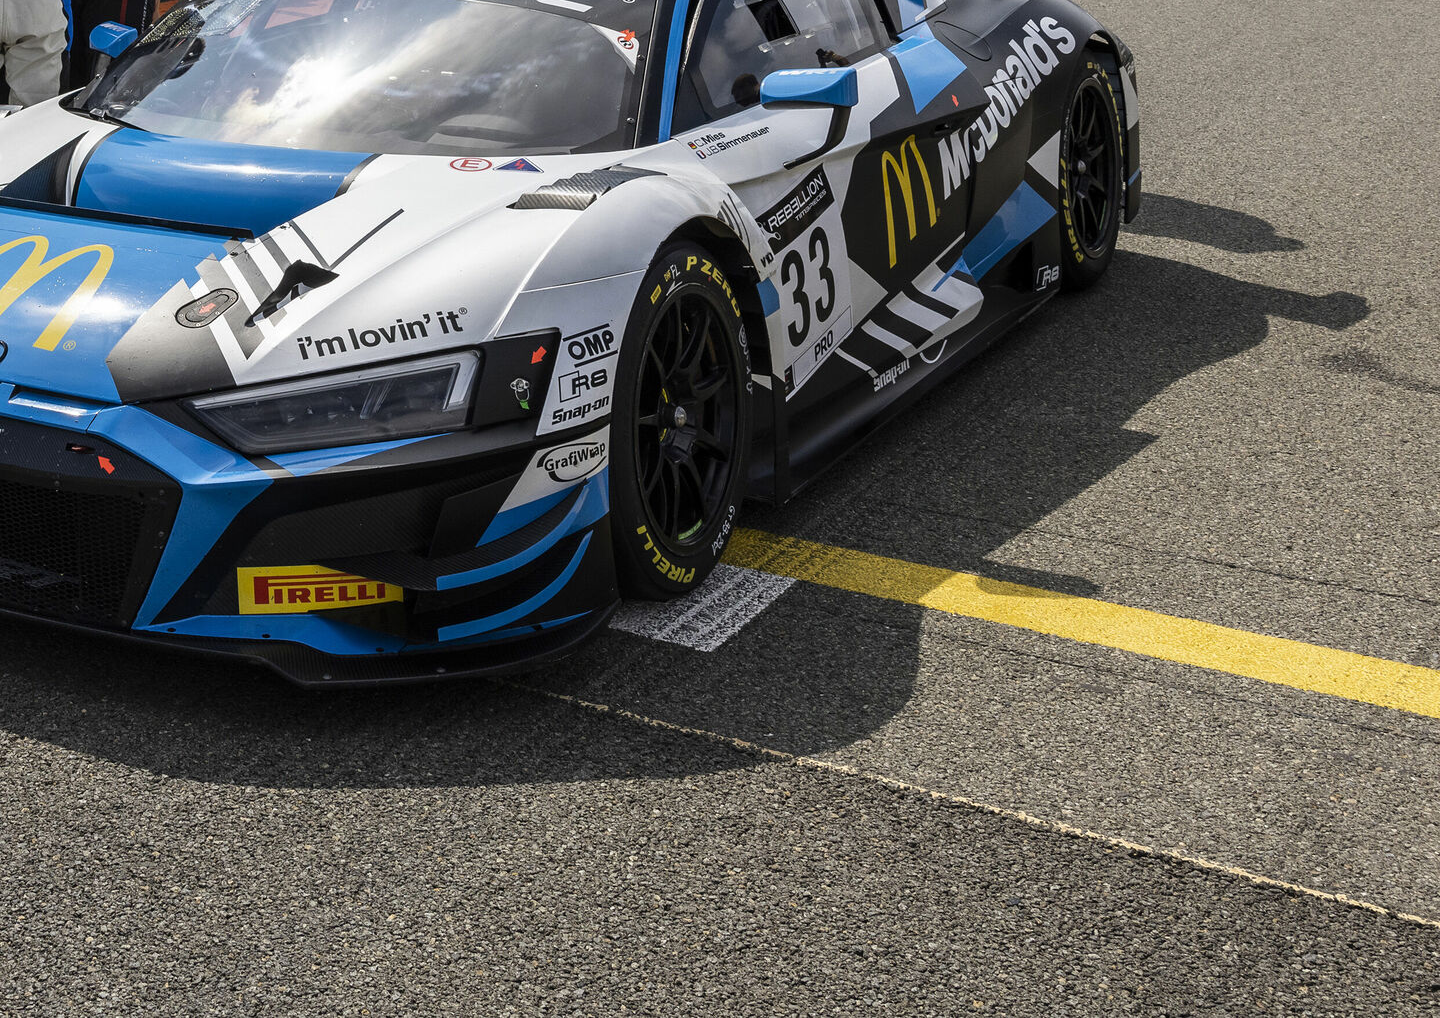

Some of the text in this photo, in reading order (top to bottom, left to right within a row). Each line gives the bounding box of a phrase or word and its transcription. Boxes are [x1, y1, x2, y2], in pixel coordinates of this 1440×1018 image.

[937, 16, 1076, 201] McDonald's
[781, 226, 836, 348] 33
[297, 336, 347, 360] i'm
[348, 314, 431, 350] lovin'
[567, 329, 614, 360] OMP
[814, 330, 834, 362] PRO
[572, 368, 608, 396] R8
[552, 395, 610, 425] Snap-on
[637, 525, 695, 583] PIRELLI
[253, 573, 386, 604] PIRELLI
